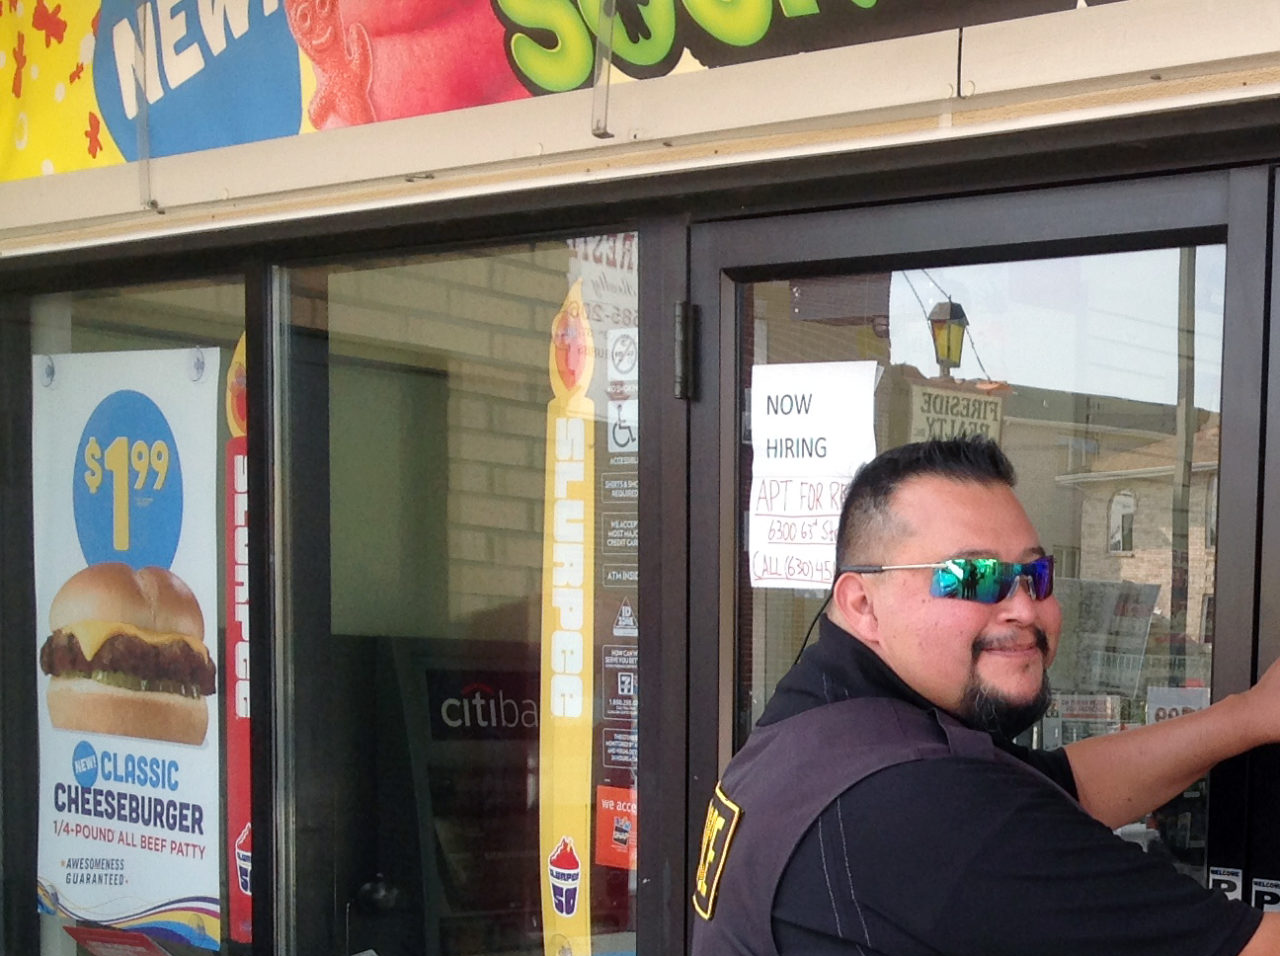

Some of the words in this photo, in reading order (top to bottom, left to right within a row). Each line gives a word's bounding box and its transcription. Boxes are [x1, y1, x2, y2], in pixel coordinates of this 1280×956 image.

[112, 0, 283, 120] NEW
[766, 394, 812, 415] NOW
[766, 437, 827, 459] HIRING
[756, 479, 792, 511] APT
[800, 482, 824, 511] FOR
[441, 689, 540, 728] citiba
[101, 750, 180, 792] CLASSIC
[54, 782, 204, 835] CHEESEBURGER
[53, 819, 115, 843] 1/4-POUND
[117, 830, 137, 848] ALL
[140, 834, 167, 853] BEEF
[170, 840, 206, 860] PATTY
[65, 872, 124, 885] GUARANTEED
[66, 858, 125, 871] AWESOMENESS
